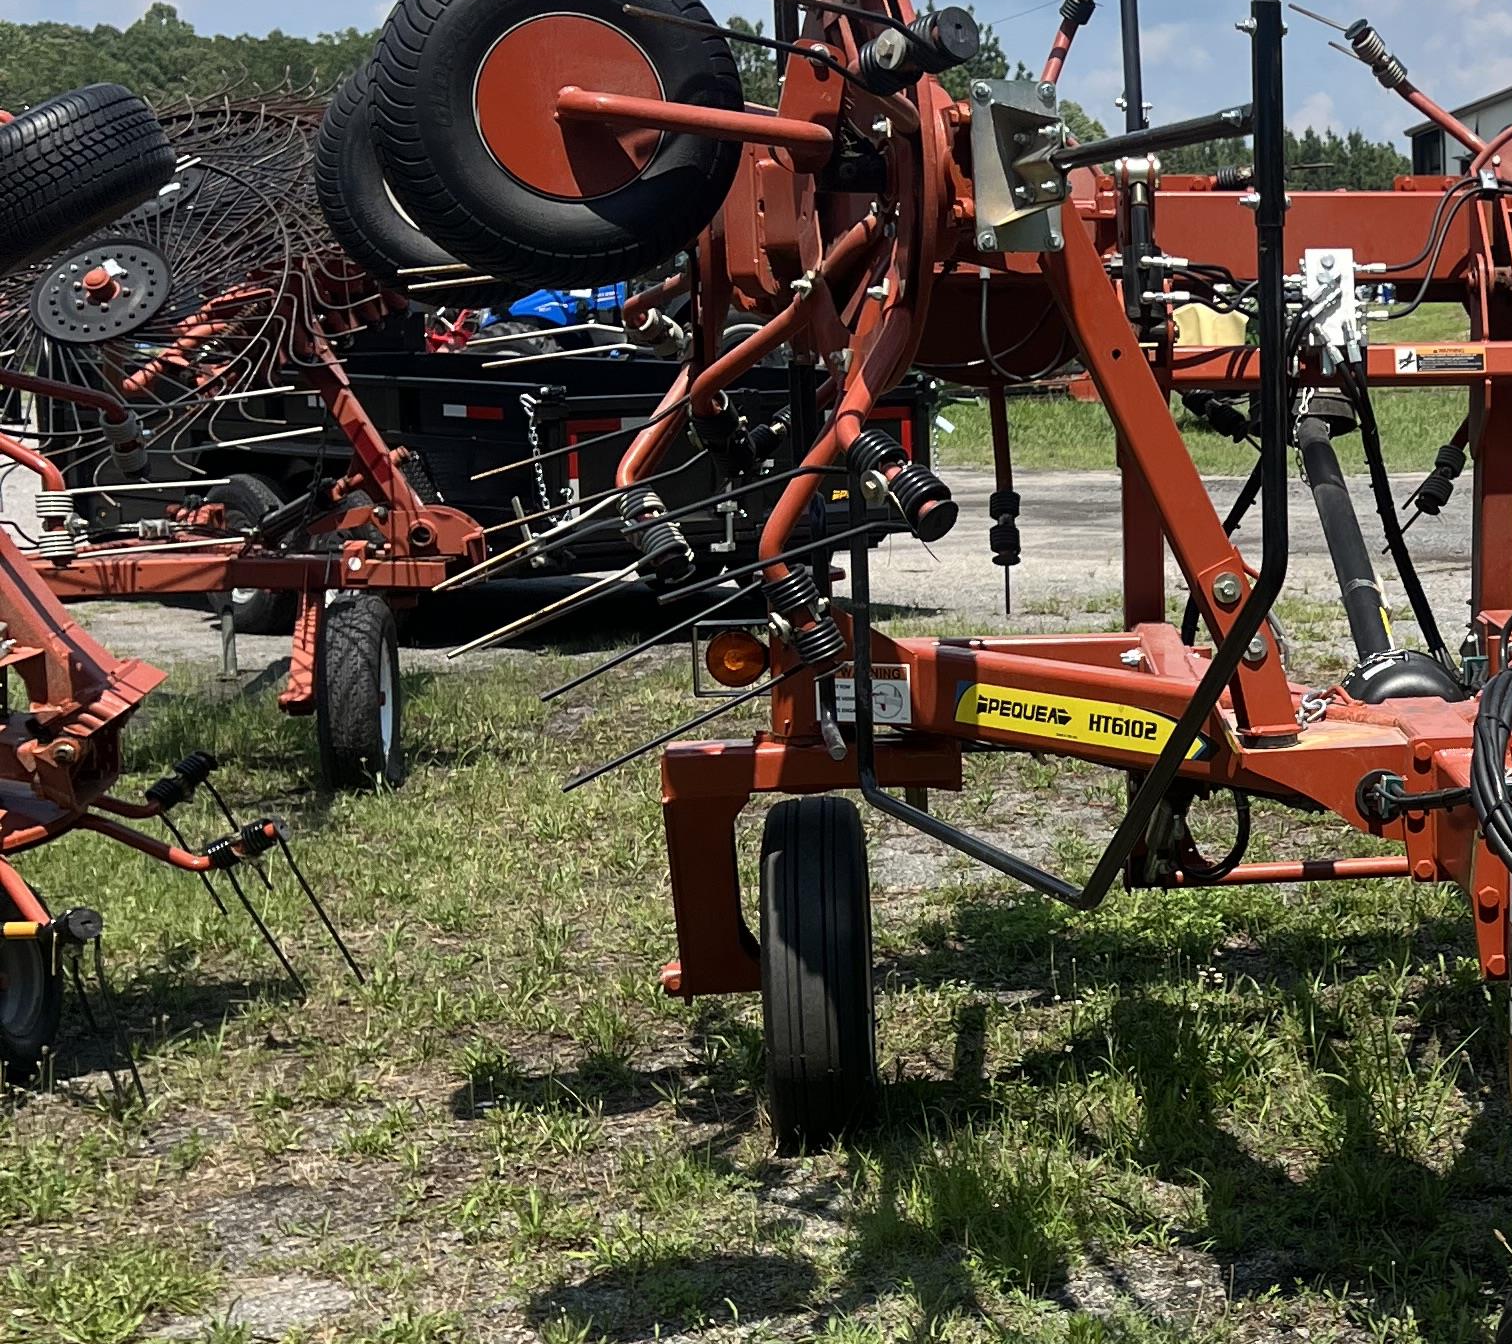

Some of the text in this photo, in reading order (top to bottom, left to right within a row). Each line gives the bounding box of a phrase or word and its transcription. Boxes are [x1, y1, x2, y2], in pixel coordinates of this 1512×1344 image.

[841, 665, 901, 679] WNING
[986, 697, 1158, 740] PEQUEA HT6102
